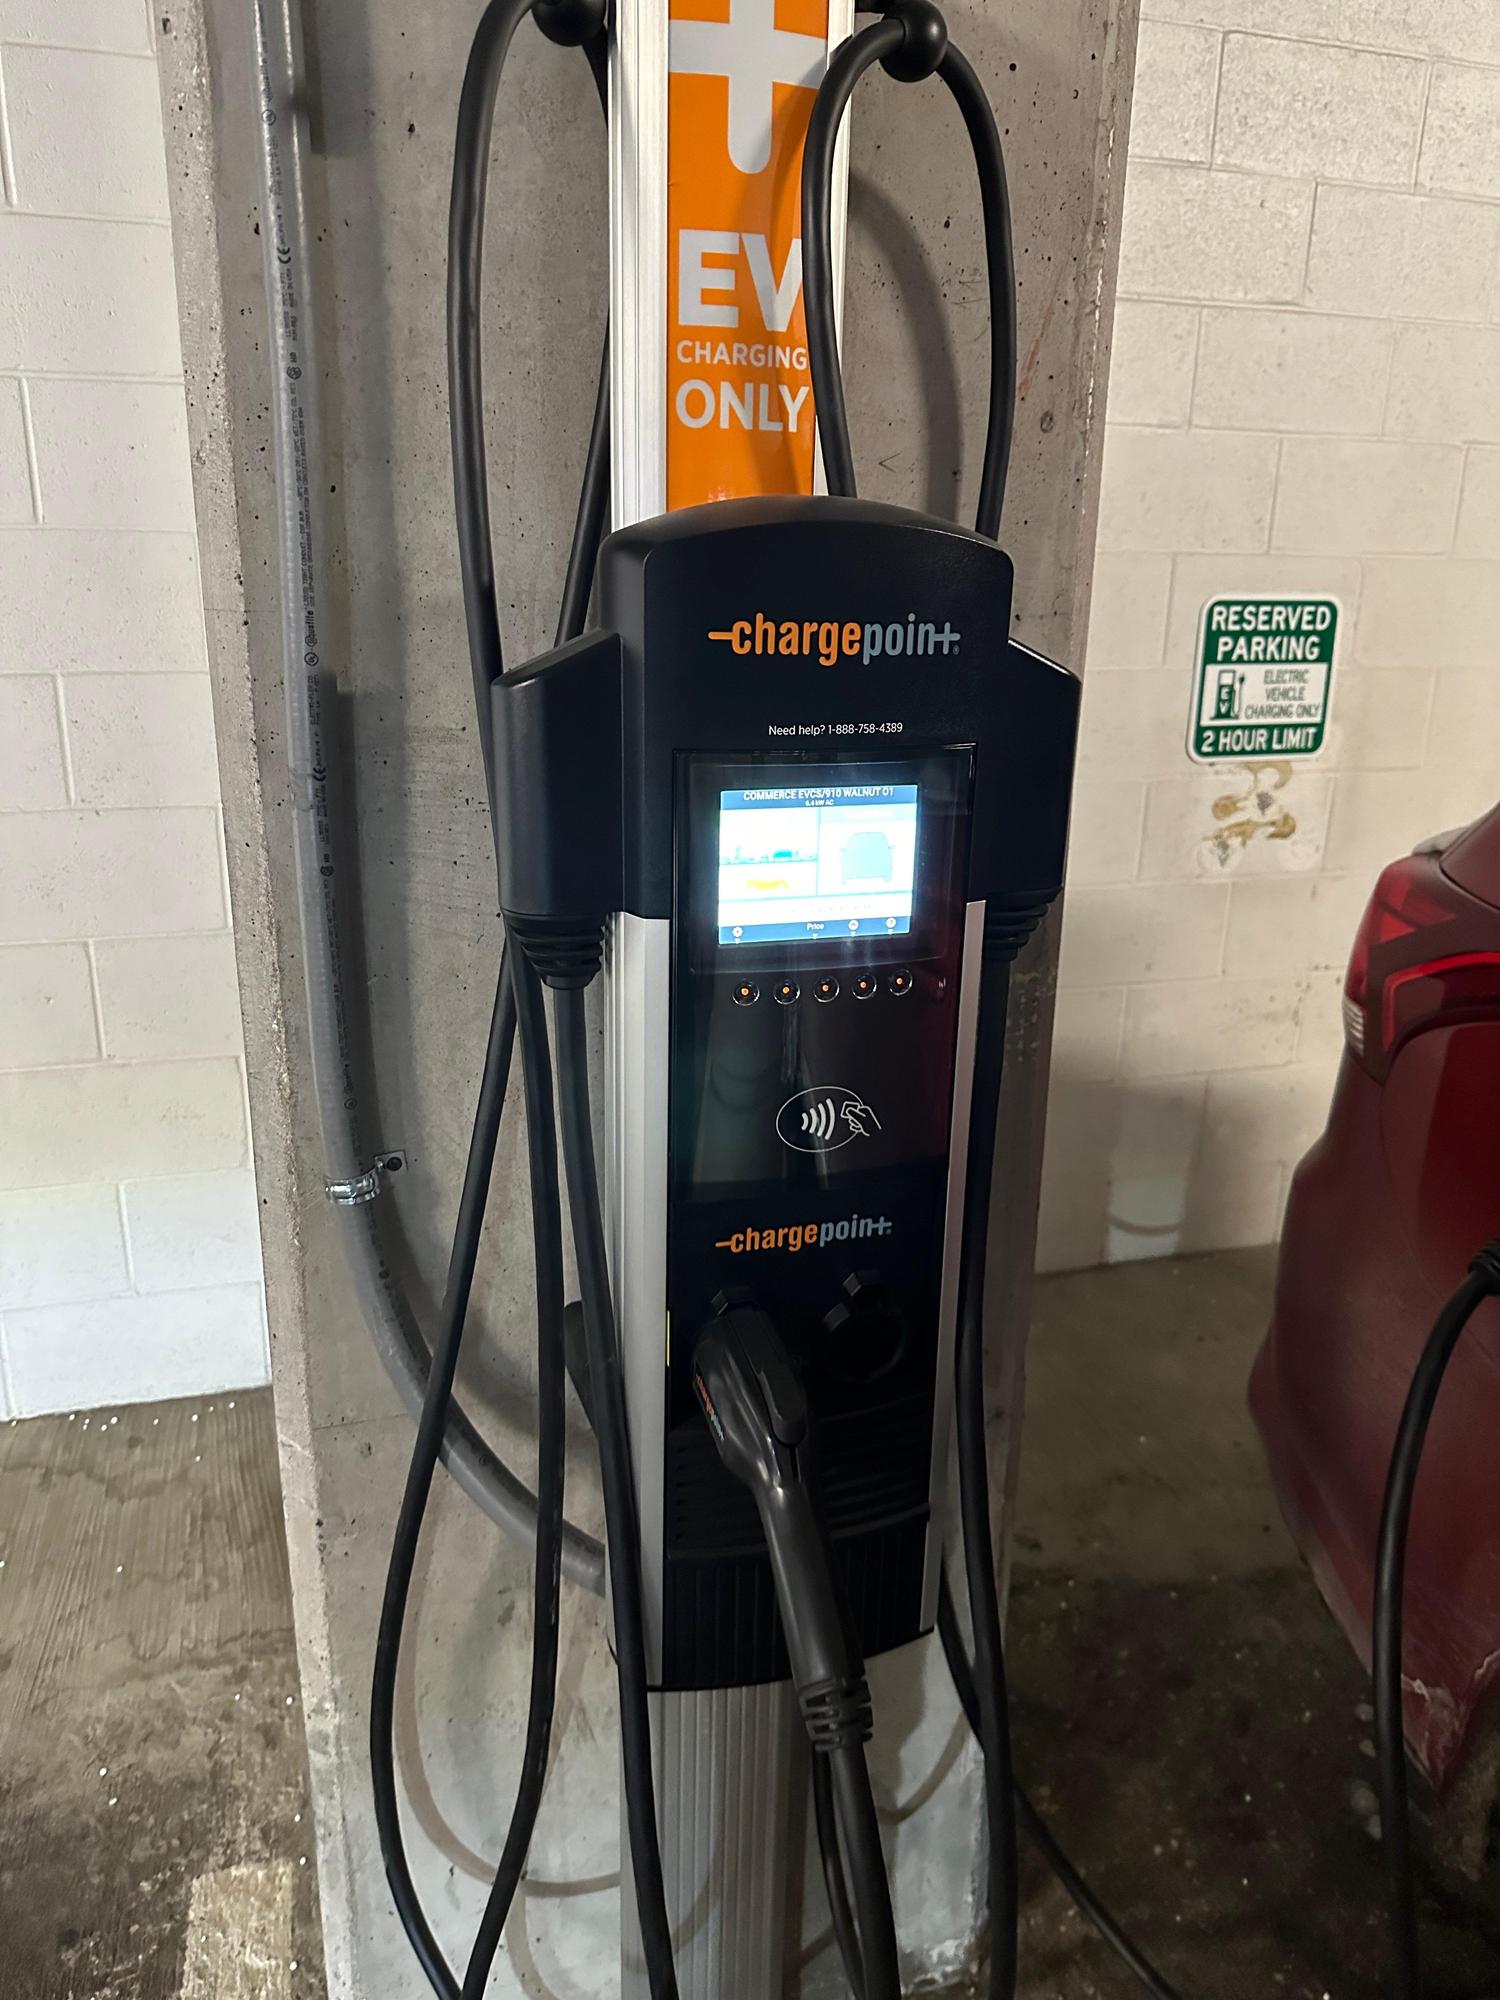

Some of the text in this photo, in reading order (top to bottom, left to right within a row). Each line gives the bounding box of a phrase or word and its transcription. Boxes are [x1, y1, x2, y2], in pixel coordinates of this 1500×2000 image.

[678, 228, 804, 333] EV
[676, 339, 808, 371] CHARGING
[675, 379, 810, 433] ONLY
[1211, 605, 1332, 632] RESERVED
[1216, 635, 1321, 662] PARKING
[1263, 669, 1310, 685] ELECTRIC
[1265, 686, 1306, 702] VEHICLE
[1244, 703, 1320, 719] CHARGING ONLY
[768, 722, 904, 737] Need help? 1-888-758-4389
[1201, 727, 1318, 752] 2 HOUR LIMIT
[743, 790, 797, 801] COMMERCE
[843, 786, 881, 798] WALNUT
[807, 923, 825, 931] Price
